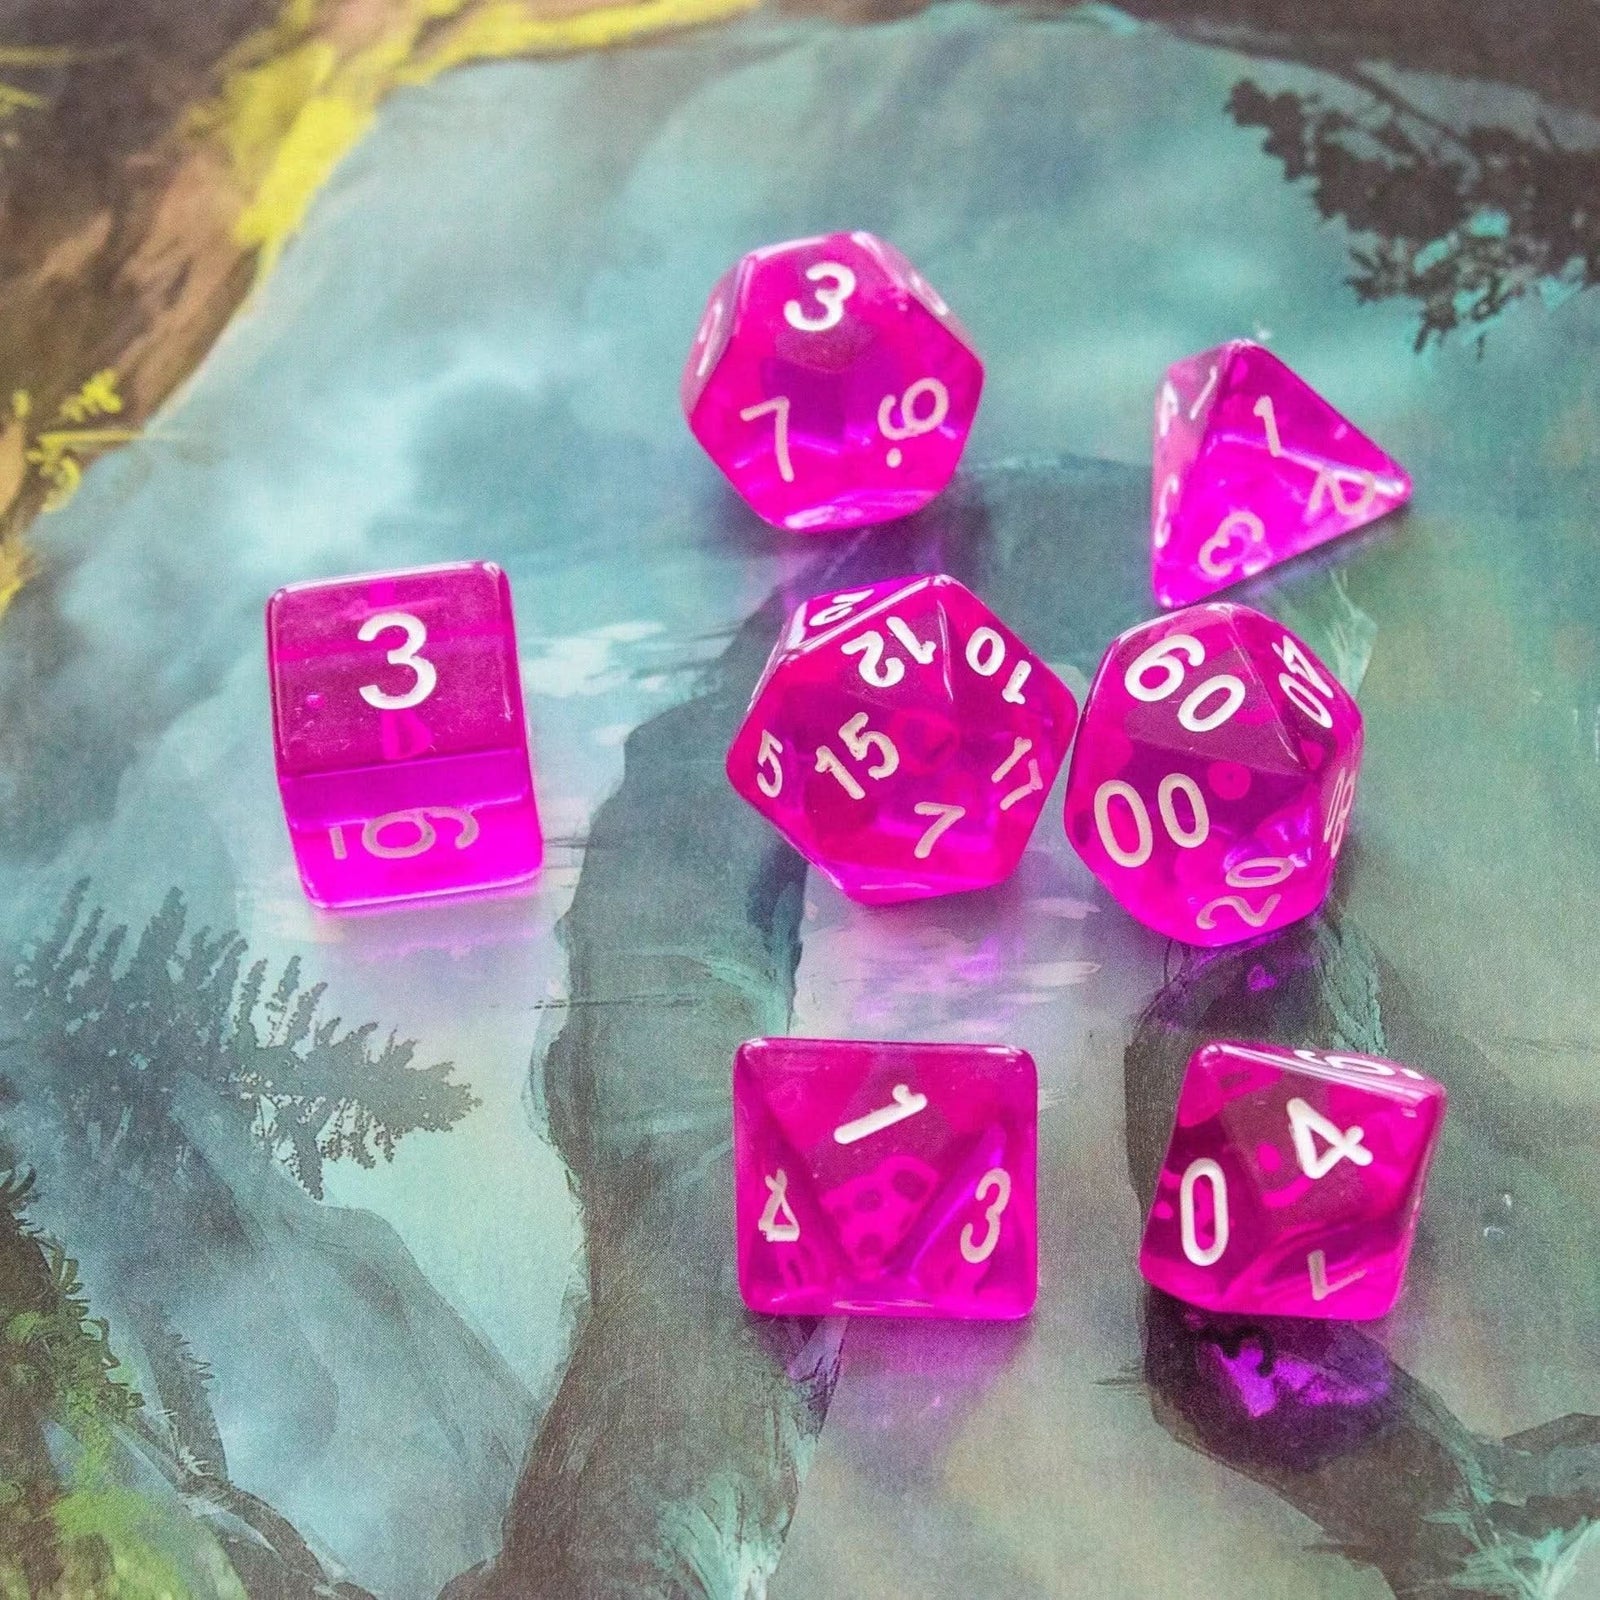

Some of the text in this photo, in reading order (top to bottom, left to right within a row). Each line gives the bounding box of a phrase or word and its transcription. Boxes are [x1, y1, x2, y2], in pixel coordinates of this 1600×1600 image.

[784, 262, 856, 331] 3
[739, 396, 795, 482] 7
[1253, 395, 1281, 457] 1
[1198, 510, 1265, 578] 3
[357, 612, 437, 710] 3
[841, 616, 937, 688] 12
[965, 626, 1032, 705] 10
[1124, 634, 1246, 733] 60
[1271, 635, 1334, 729] 40
[756, 729, 784, 798] 5
[814, 712, 900, 800] 15
[991, 736, 1044, 811] 17
[914, 801, 966, 859] 7
[1093, 772, 1210, 868] 00
[1196, 857, 1296, 930] 20
[833, 1083, 928, 1145] 1
[1286, 1097, 1374, 1180] 4
[757, 1168, 801, 1243] 4
[960, 1168, 1012, 1264] 3
[1179, 1157, 1230, 1267] 0
